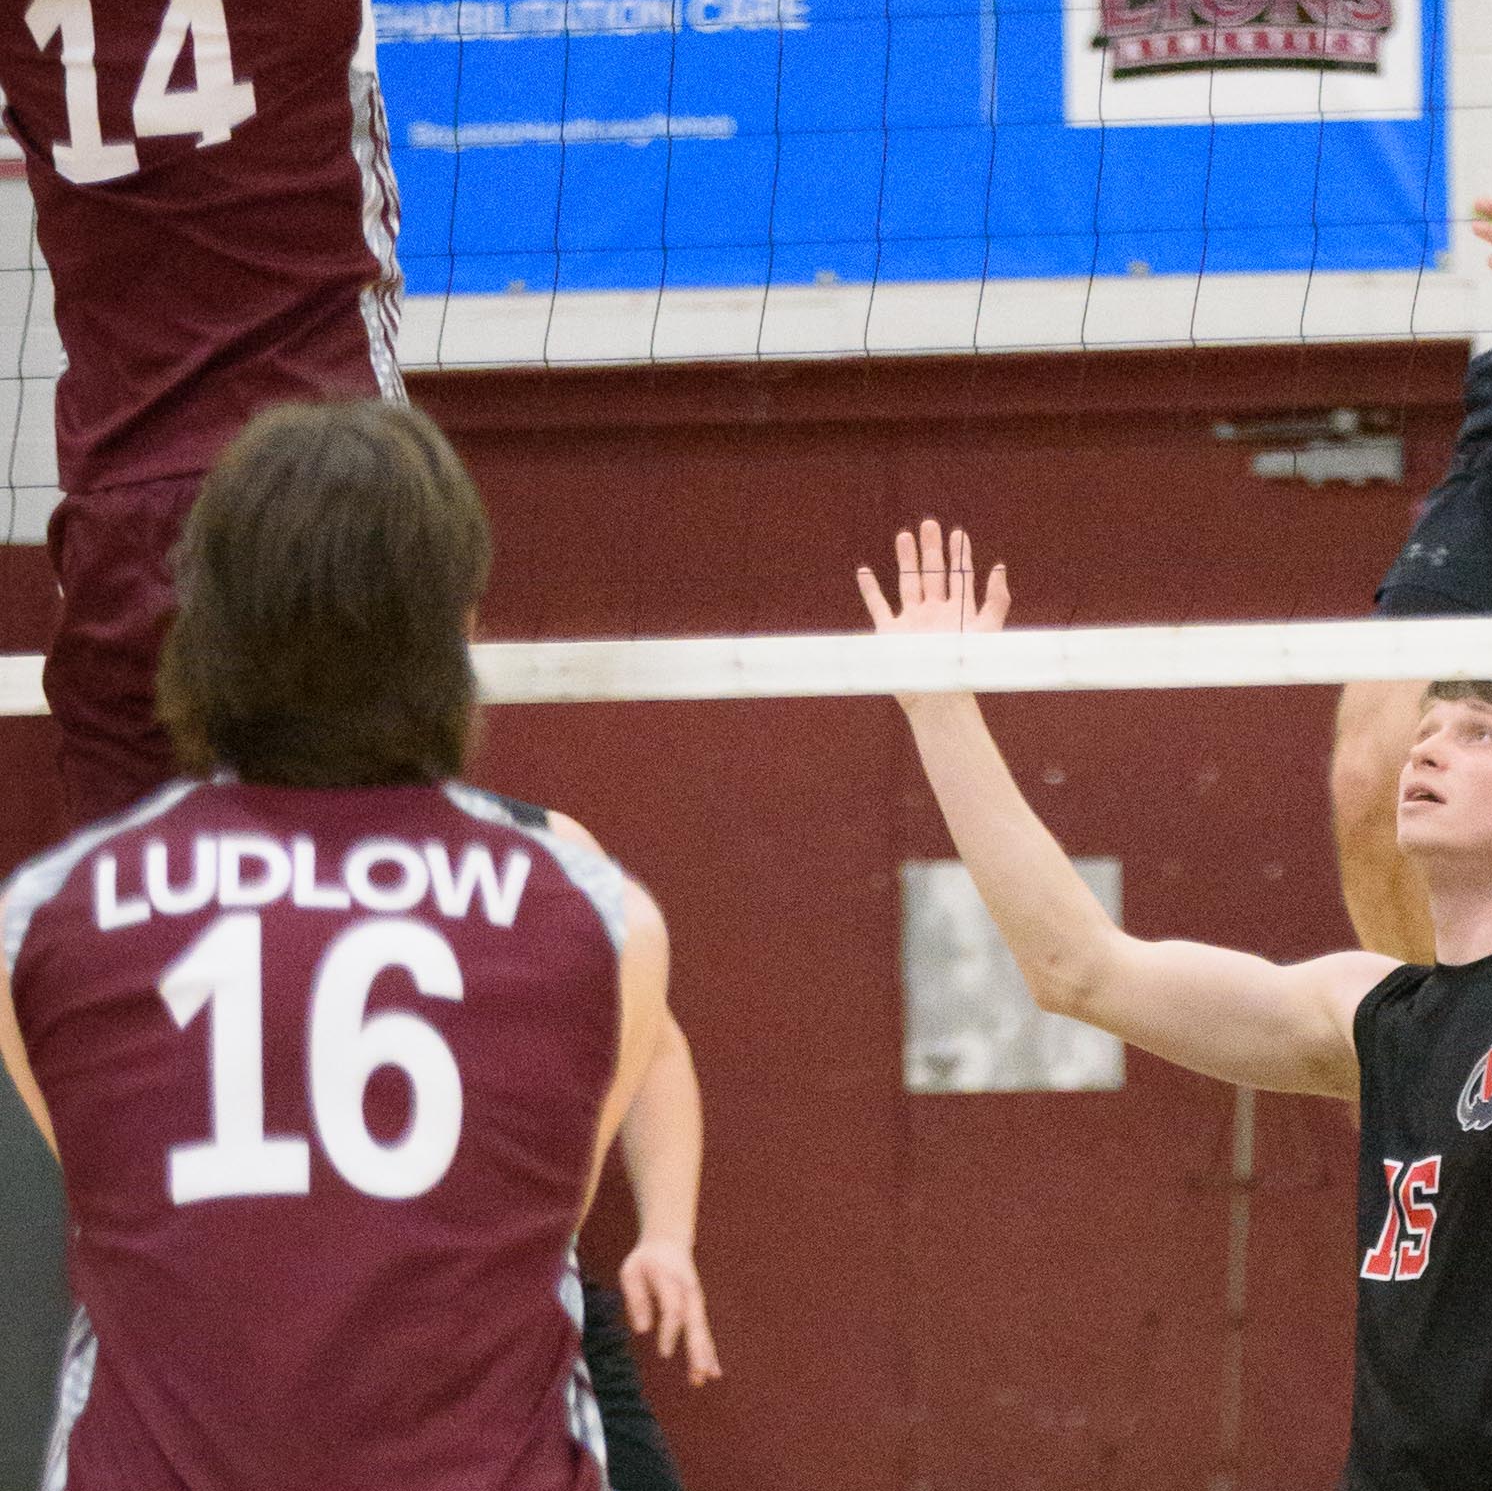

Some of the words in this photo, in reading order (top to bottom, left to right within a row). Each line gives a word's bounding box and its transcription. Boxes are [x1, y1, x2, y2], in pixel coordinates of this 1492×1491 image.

[97, 834, 531, 931] LUDLOW
[158, 911, 464, 1205] 16
[1360, 1154, 1442, 1282] 15
